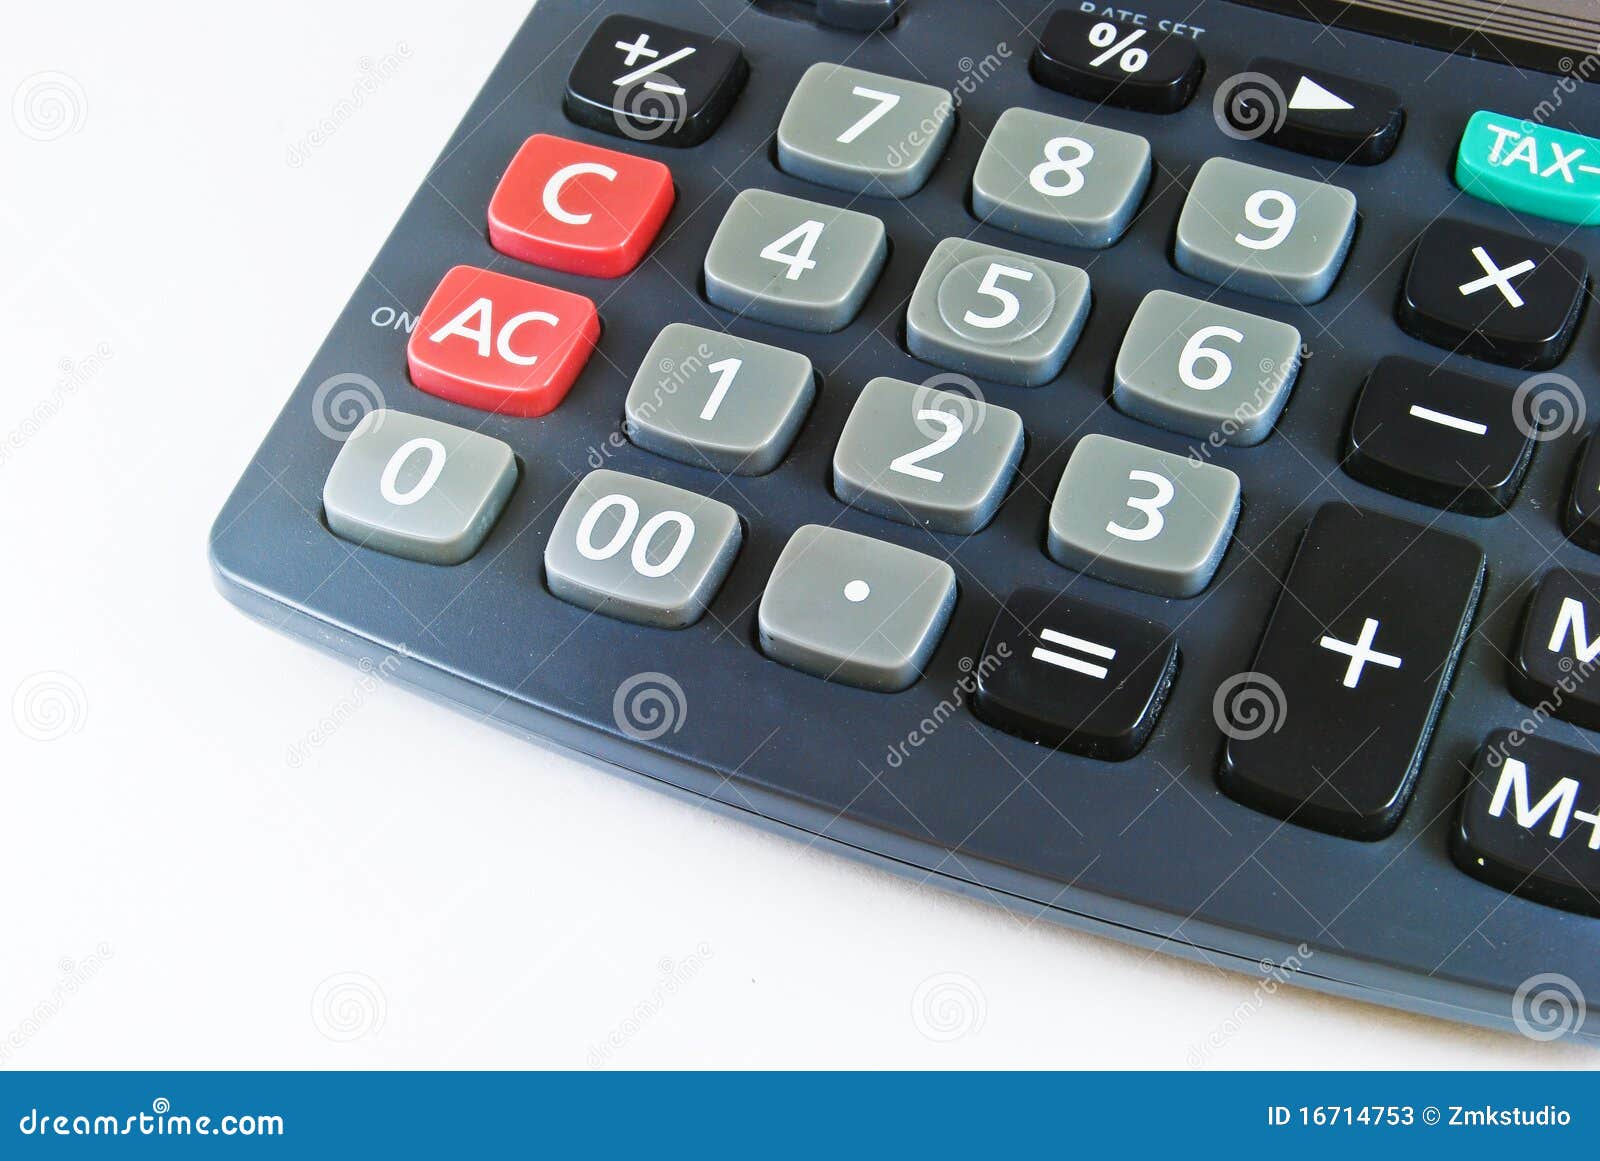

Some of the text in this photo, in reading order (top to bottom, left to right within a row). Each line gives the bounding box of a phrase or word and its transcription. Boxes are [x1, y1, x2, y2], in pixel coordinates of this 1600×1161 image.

[836, 86, 901, 144] 7
[541, 162, 618, 225] C
[1029, 136, 1095, 197] 8
[759, 219, 825, 281] 4
[1235, 189, 1297, 250] 9
[371, 306, 420, 333] ON
[963, 262, 1034, 329] 5
[429, 297, 560, 366] AC
[1178, 325, 1244, 391] 6
[699, 357, 743, 421] 1
[379, 437, 447, 506] 0
[889, 408, 964, 483] 2
[575, 493, 696, 578] 00
[1105, 469, 1175, 541] 3
